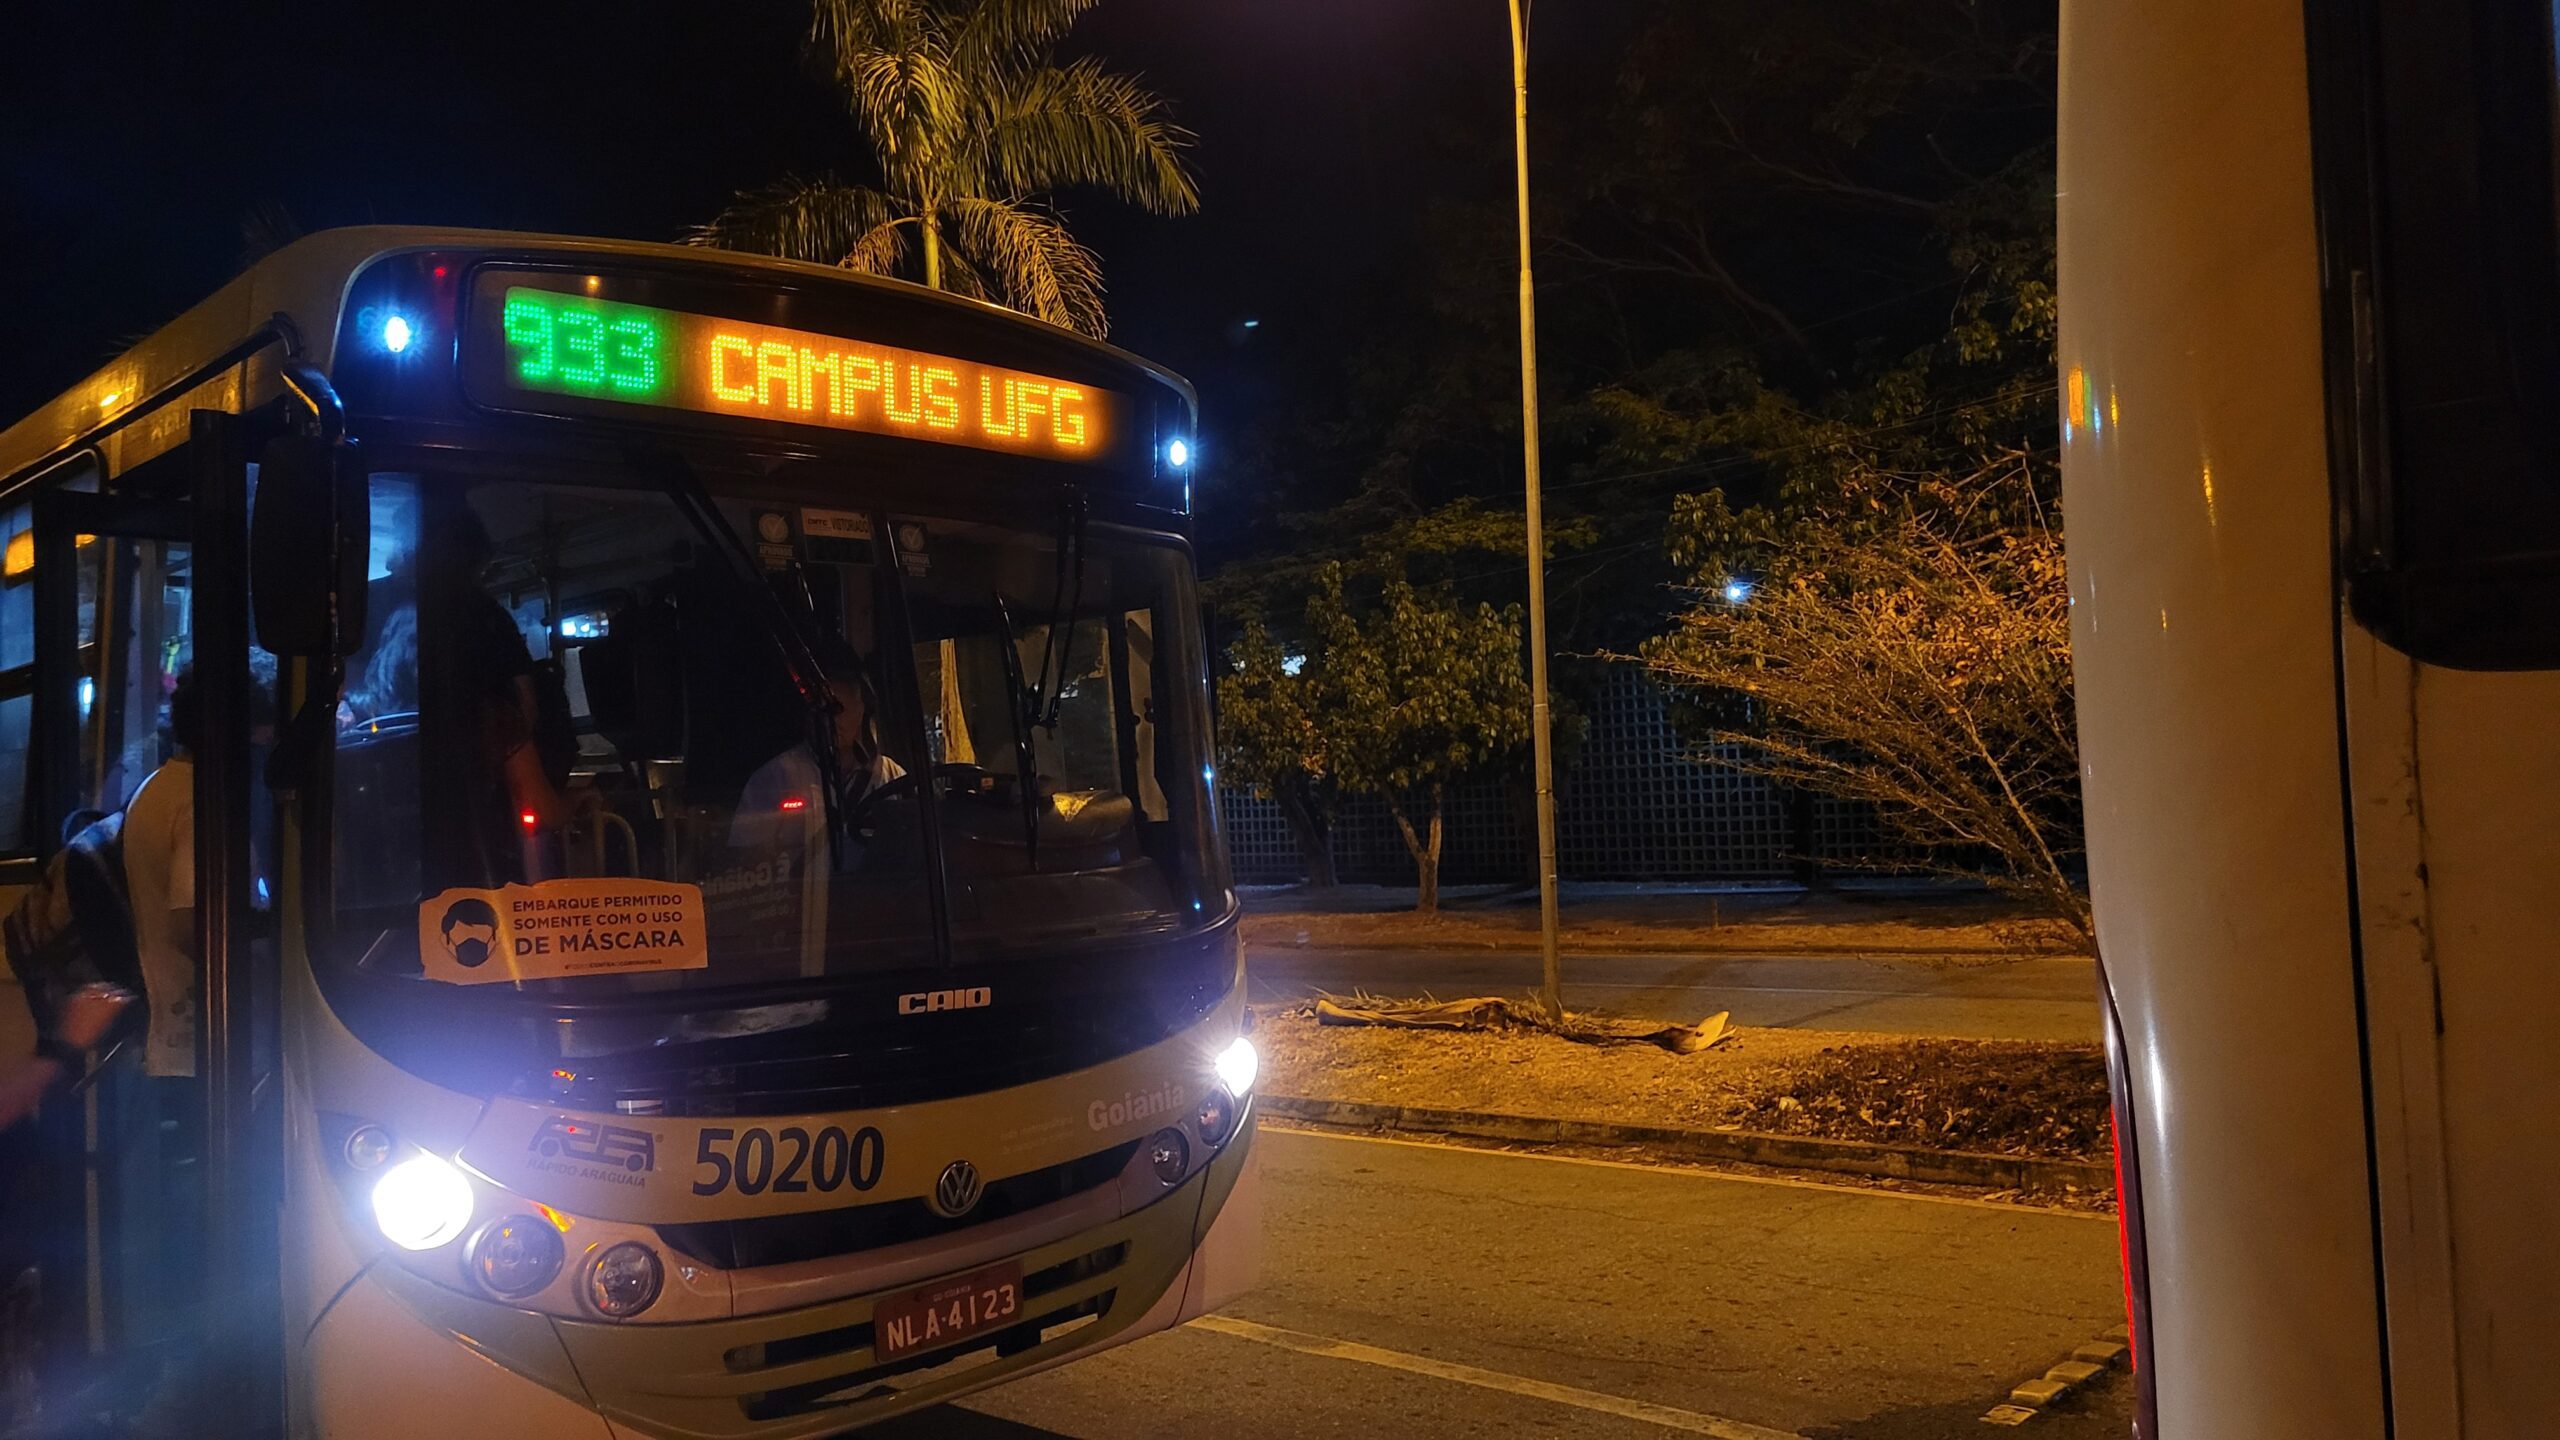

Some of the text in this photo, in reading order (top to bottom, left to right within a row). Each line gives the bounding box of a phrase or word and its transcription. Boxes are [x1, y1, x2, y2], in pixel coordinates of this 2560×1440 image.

[504, 301, 1085, 445] 933 CAMPUS UFG
[513, 894, 683, 913] EMBARQUE PERMITIDO
[514, 911, 683, 931] SOMENTE COM O USO
[515, 929, 685, 957] DE MÁSCARA
[898, 986, 992, 1015] CAIO
[1087, 1081, 1186, 1132] Goiânia
[692, 1125, 885, 1197] 50200
[580, 1166, 646, 1189] ARAGUAIA
